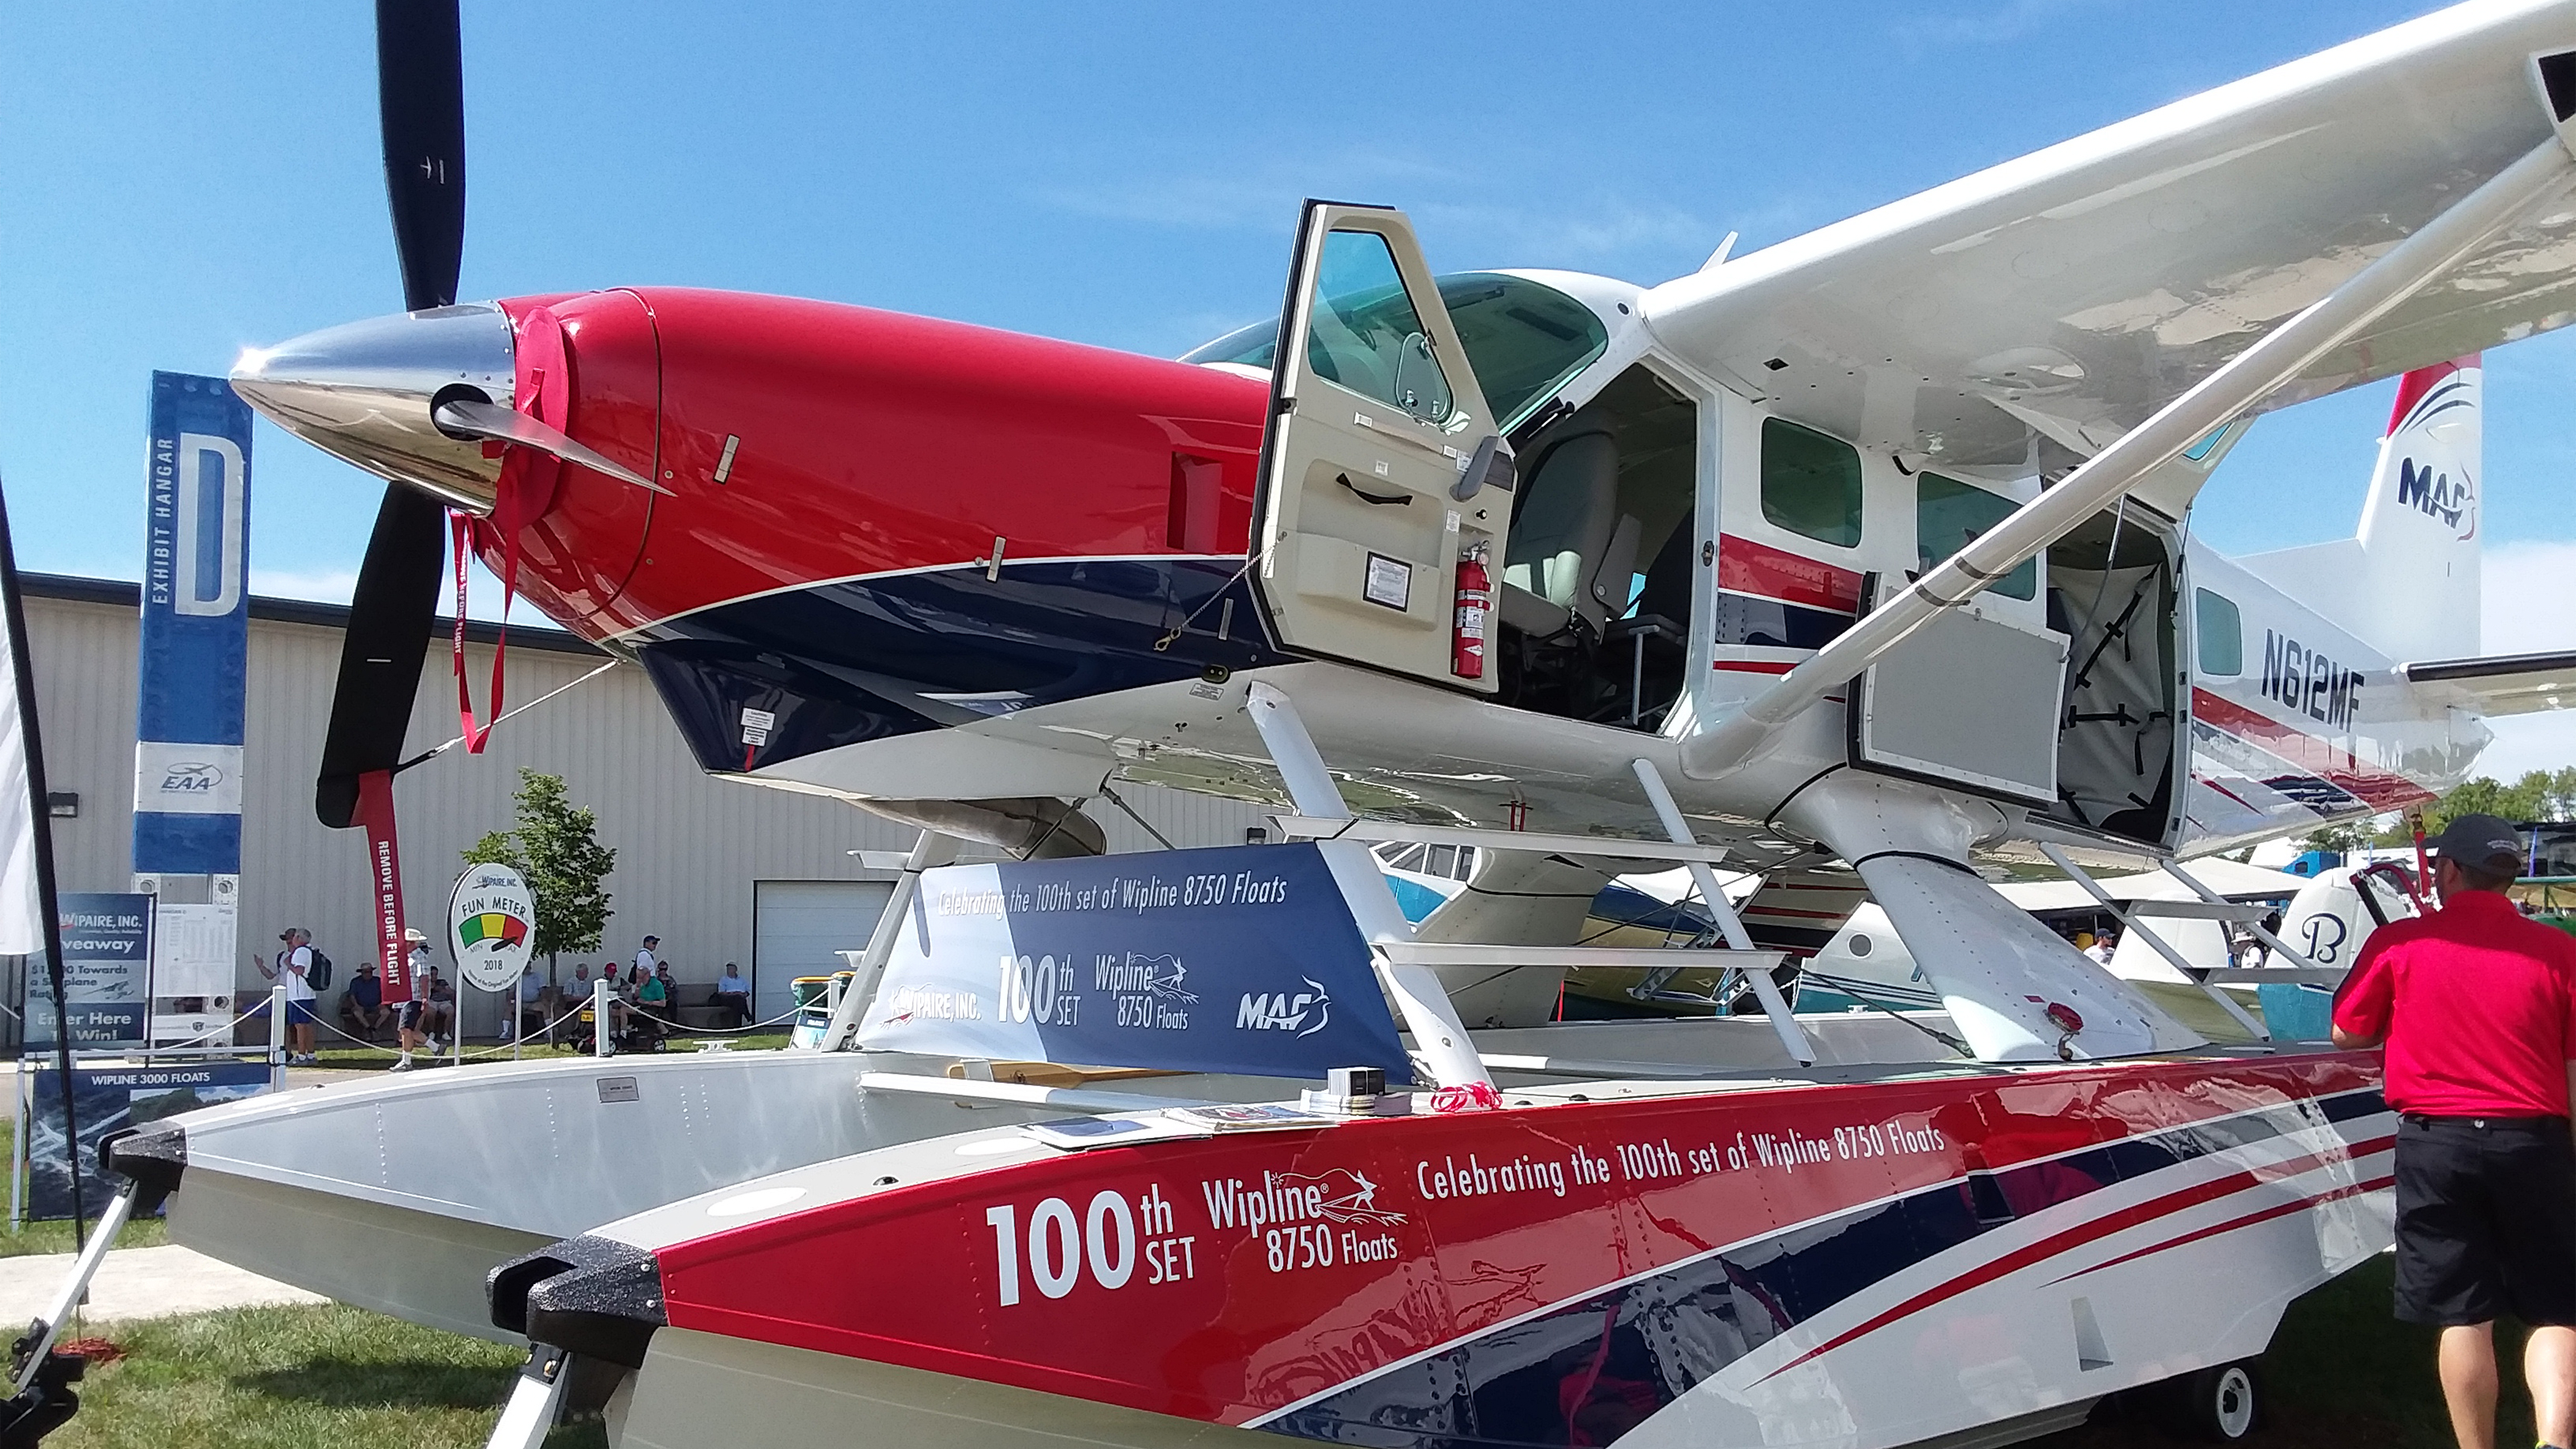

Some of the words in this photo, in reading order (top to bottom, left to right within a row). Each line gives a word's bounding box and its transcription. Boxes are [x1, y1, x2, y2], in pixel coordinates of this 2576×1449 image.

[155, 438, 173, 518] HANGAR
[2398, 456, 2466, 529] MAF
[175, 432, 244, 617] D
[152, 527, 170, 604] EXHIBIT
[2260, 629, 2365, 733] N612MF
[161, 776, 210, 791] EAA
[378, 840, 394, 891] REMOVE
[382, 894, 397, 940] BEFORE
[461, 897, 485, 917] FUN
[492, 897, 526, 919] METER
[938, 886, 1005, 921] Celebrating
[1009, 883, 1030, 913] the
[1035, 881, 1071, 912] 100th
[1075, 885, 1097, 910] set
[1101, 877, 1120, 910] of
[1122, 875, 1178, 915] Wipline
[1183, 873, 1228, 906] 8750
[1231, 870, 1288, 904] Floats
[118, 914, 143, 927] INC.
[2301, 913, 2347, 964] B
[78, 964, 128, 975] Towards
[386, 943, 401, 986] FLIGHT
[469, 943, 483, 954] MIN
[484, 960, 503, 971] 2018
[504, 946, 517, 954] AX
[955, 992, 982, 1021] INC.
[998, 955, 1056, 1024] 100
[1059, 954, 1075, 992] th
[37, 1012, 84, 1026] Ener
[89, 1012, 132, 1026] Here
[1057, 996, 1081, 1026] SET
[1117, 995, 1154, 1028] 8750
[1156, 1002, 1189, 1030] Floats
[1236, 992, 1312, 1031] MAF
[76, 1029, 118, 1041] Win!
[91, 1075, 137, 1085] WIPLINE
[139, 1074, 168, 1084] 3000
[171, 1072, 210, 1084] FLOATS
[1418, 1153, 1567, 1199] Celebrating
[1571, 1145, 1611, 1186] the
[1616, 1138, 1683, 1181] 100th
[1688, 1142, 1721, 1174] set
[1727, 1131, 1750, 1171] of
[1751, 1128, 1832, 1174] Wipline
[1833, 1125, 1885, 1160] 8750
[1886, 1119, 1946, 1155] Floats
[986, 1190, 1136, 1307] 100
[1141, 1183, 1174, 1236] th
[1145, 1236, 1195, 1284] SET
[1266, 1224, 1334, 1273] 8750
[1341, 1229, 1398, 1265] Floats
